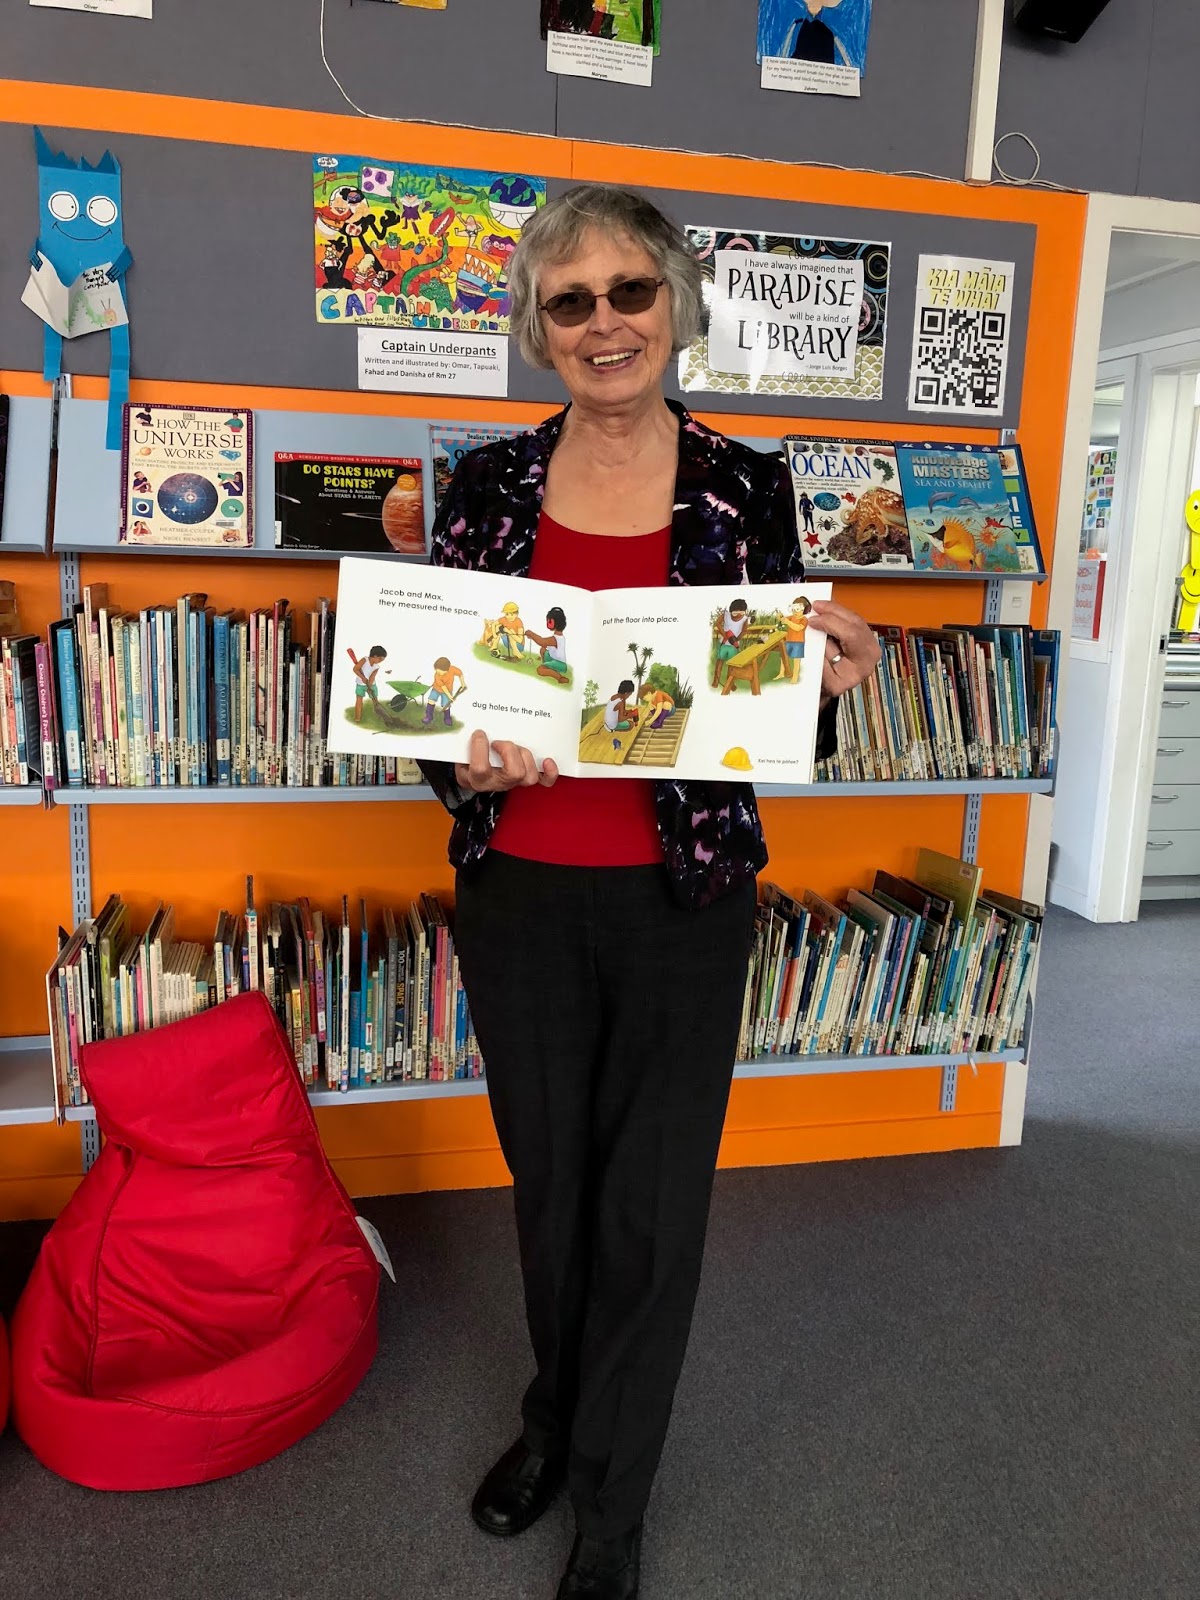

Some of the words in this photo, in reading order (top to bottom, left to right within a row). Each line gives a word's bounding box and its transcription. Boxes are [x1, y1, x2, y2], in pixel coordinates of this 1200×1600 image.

[744, 259, 748, 267] I
[749, 259, 769, 269] have
[770, 260, 798, 273] always
[799, 262, 836, 274] imagined
[837, 264, 853, 275] that
[927, 268, 960, 288] KIA
[929, 287, 952, 306] TE
[954, 289, 1000, 310] WHAI
[412, 315, 511, 331] UNDERPANT
[789, 312, 803, 321] will
[804, 313, 815, 321] be
[823, 313, 839, 323] kind
[841, 315, 850, 324] of
[381, 339, 426, 352] Captain
[429, 342, 497, 357] Underpants
[364, 357, 390, 365] Written
[392, 358, 404, 366] and
[405, 358, 439, 367] illustrated
[440, 360, 451, 369] by:
[451, 362, 472, 370] Omar,
[473, 362, 500, 371] Tapuaki,
[364, 368, 385, 376] Fahad
[386, 369, 399, 377] and
[400, 370, 426, 378] Danisha
[448, 372, 456, 380] 27
[157, 419, 190, 430] HOW
[194, 420, 221, 431] THE
[133, 429, 243, 448] UNIVERSE
[163, 448, 214, 459] WORKS
[303, 464, 321, 474] DO
[323, 466, 361, 476] STARS
[364, 467, 395, 479] HAVE
[791, 453, 871, 479] OCEAN
[912, 465, 990, 480] MASTERS
[323, 477, 375, 489] POINTS?
[933, 480, 955, 488] AND
[379, 587, 405, 597] Jacob
[406, 589, 423, 598] and
[424, 592, 444, 601] Max,
[379, 599, 396, 608] they
[398, 601, 438, 611] measured
[439, 605, 453, 613] the
[454, 608, 480, 619] space,
[602, 616, 613, 626] put
[656, 615, 679, 624] place.
[63, 635, 71, 659] Usborne
[63, 660, 72, 675] Fairy
[65, 676, 73, 690] Tales
[220, 672, 226, 682] OF
[40, 689, 48, 718] Children's
[67, 701, 75, 716] Little
[472, 701, 487, 711] dug
[489, 703, 509, 712] holes
[510, 705, 520, 713] for
[521, 707, 533, 715] the
[534, 709, 553, 719] piles,
[396, 982, 404, 1005] SPACE
